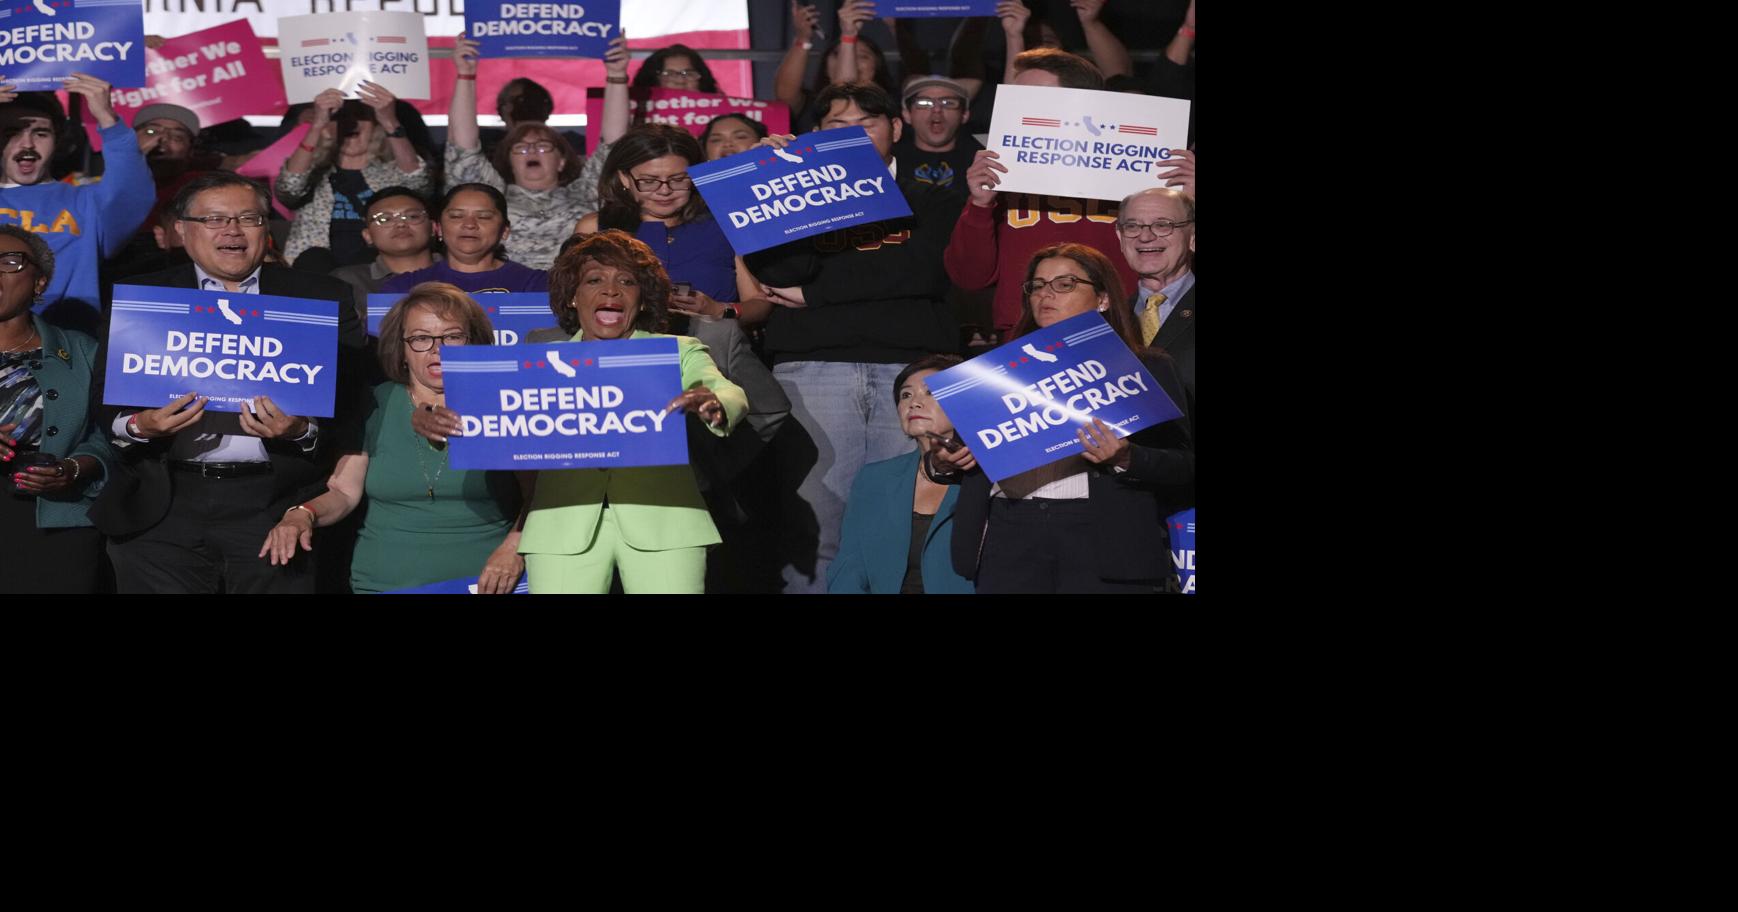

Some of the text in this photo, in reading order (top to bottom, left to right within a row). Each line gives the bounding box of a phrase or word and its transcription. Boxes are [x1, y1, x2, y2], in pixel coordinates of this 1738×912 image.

[501, 4, 585, 19] DEFEND
[473, 20, 613, 38] DEMOCRACY
[201, 41, 241, 61] We
[291, 52, 353, 67] ELECTION
[171, 74, 207, 91] for
[212, 60, 246, 84] All
[380, 63, 408, 74] ACT
[1002, 135, 1171, 159] ELECTION RIGGING
[1017, 151, 1153, 173] RESPONSE ACT
[751, 164, 847, 201] DEFEND
[728, 176, 885, 229] DEMOCRACY
[166, 331, 283, 358] DEFEND
[122, 353, 323, 385] DEMOCRACY
[500, 385, 624, 412] DEFEND
[1001, 359, 1107, 415] DEFEND
[462, 409, 667, 437] DEMOCRACY
[976, 372, 1148, 450] DEMOCRACY
